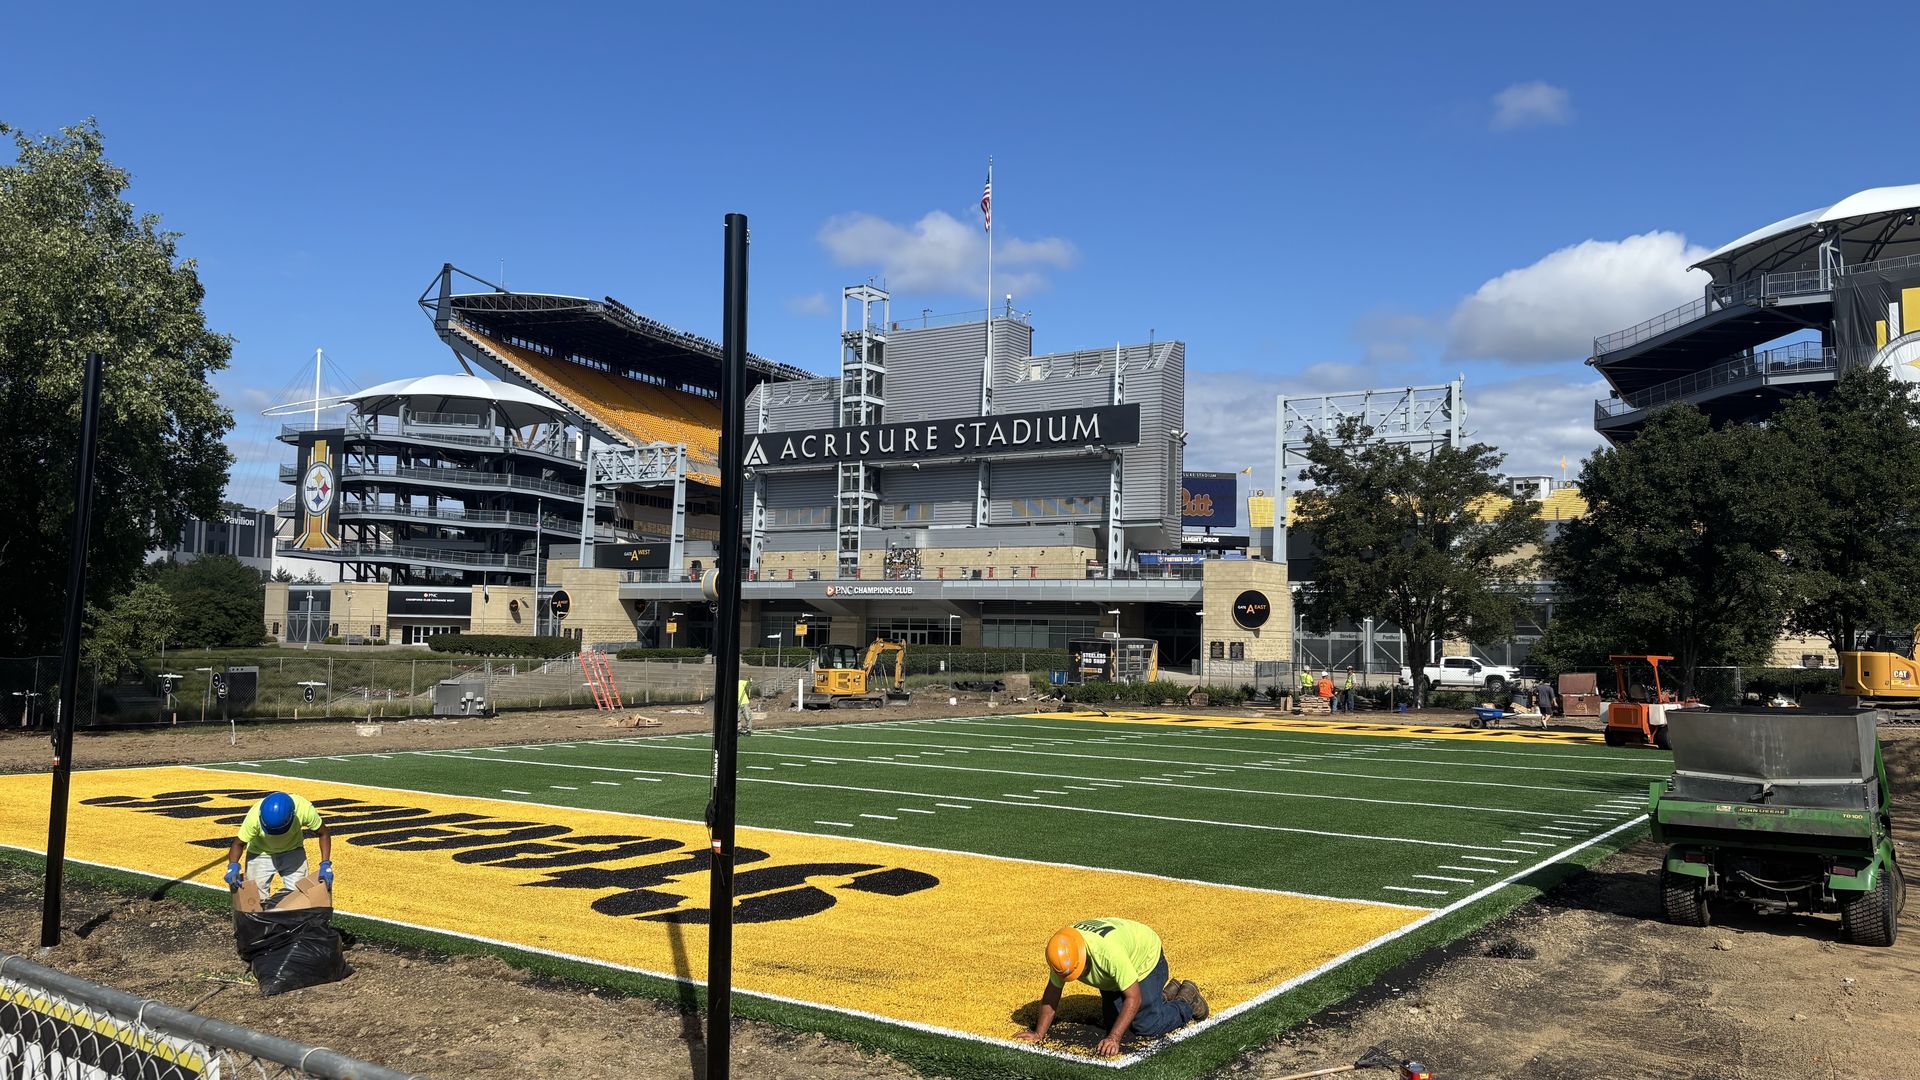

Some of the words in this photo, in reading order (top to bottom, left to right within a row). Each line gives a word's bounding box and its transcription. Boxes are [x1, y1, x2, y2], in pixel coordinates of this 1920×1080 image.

[780, 426, 938, 460] ACRISURE
[954, 413, 1101, 449] STADIUM
[224, 515, 255, 526] Pavilion
[631, 549, 639, 561] A
[835, 586, 853, 595] PNC
[854, 586, 894, 594] CHAMPIONS
[1246, 604, 1255, 614] A
[1893, 670, 1907, 678] CAT
